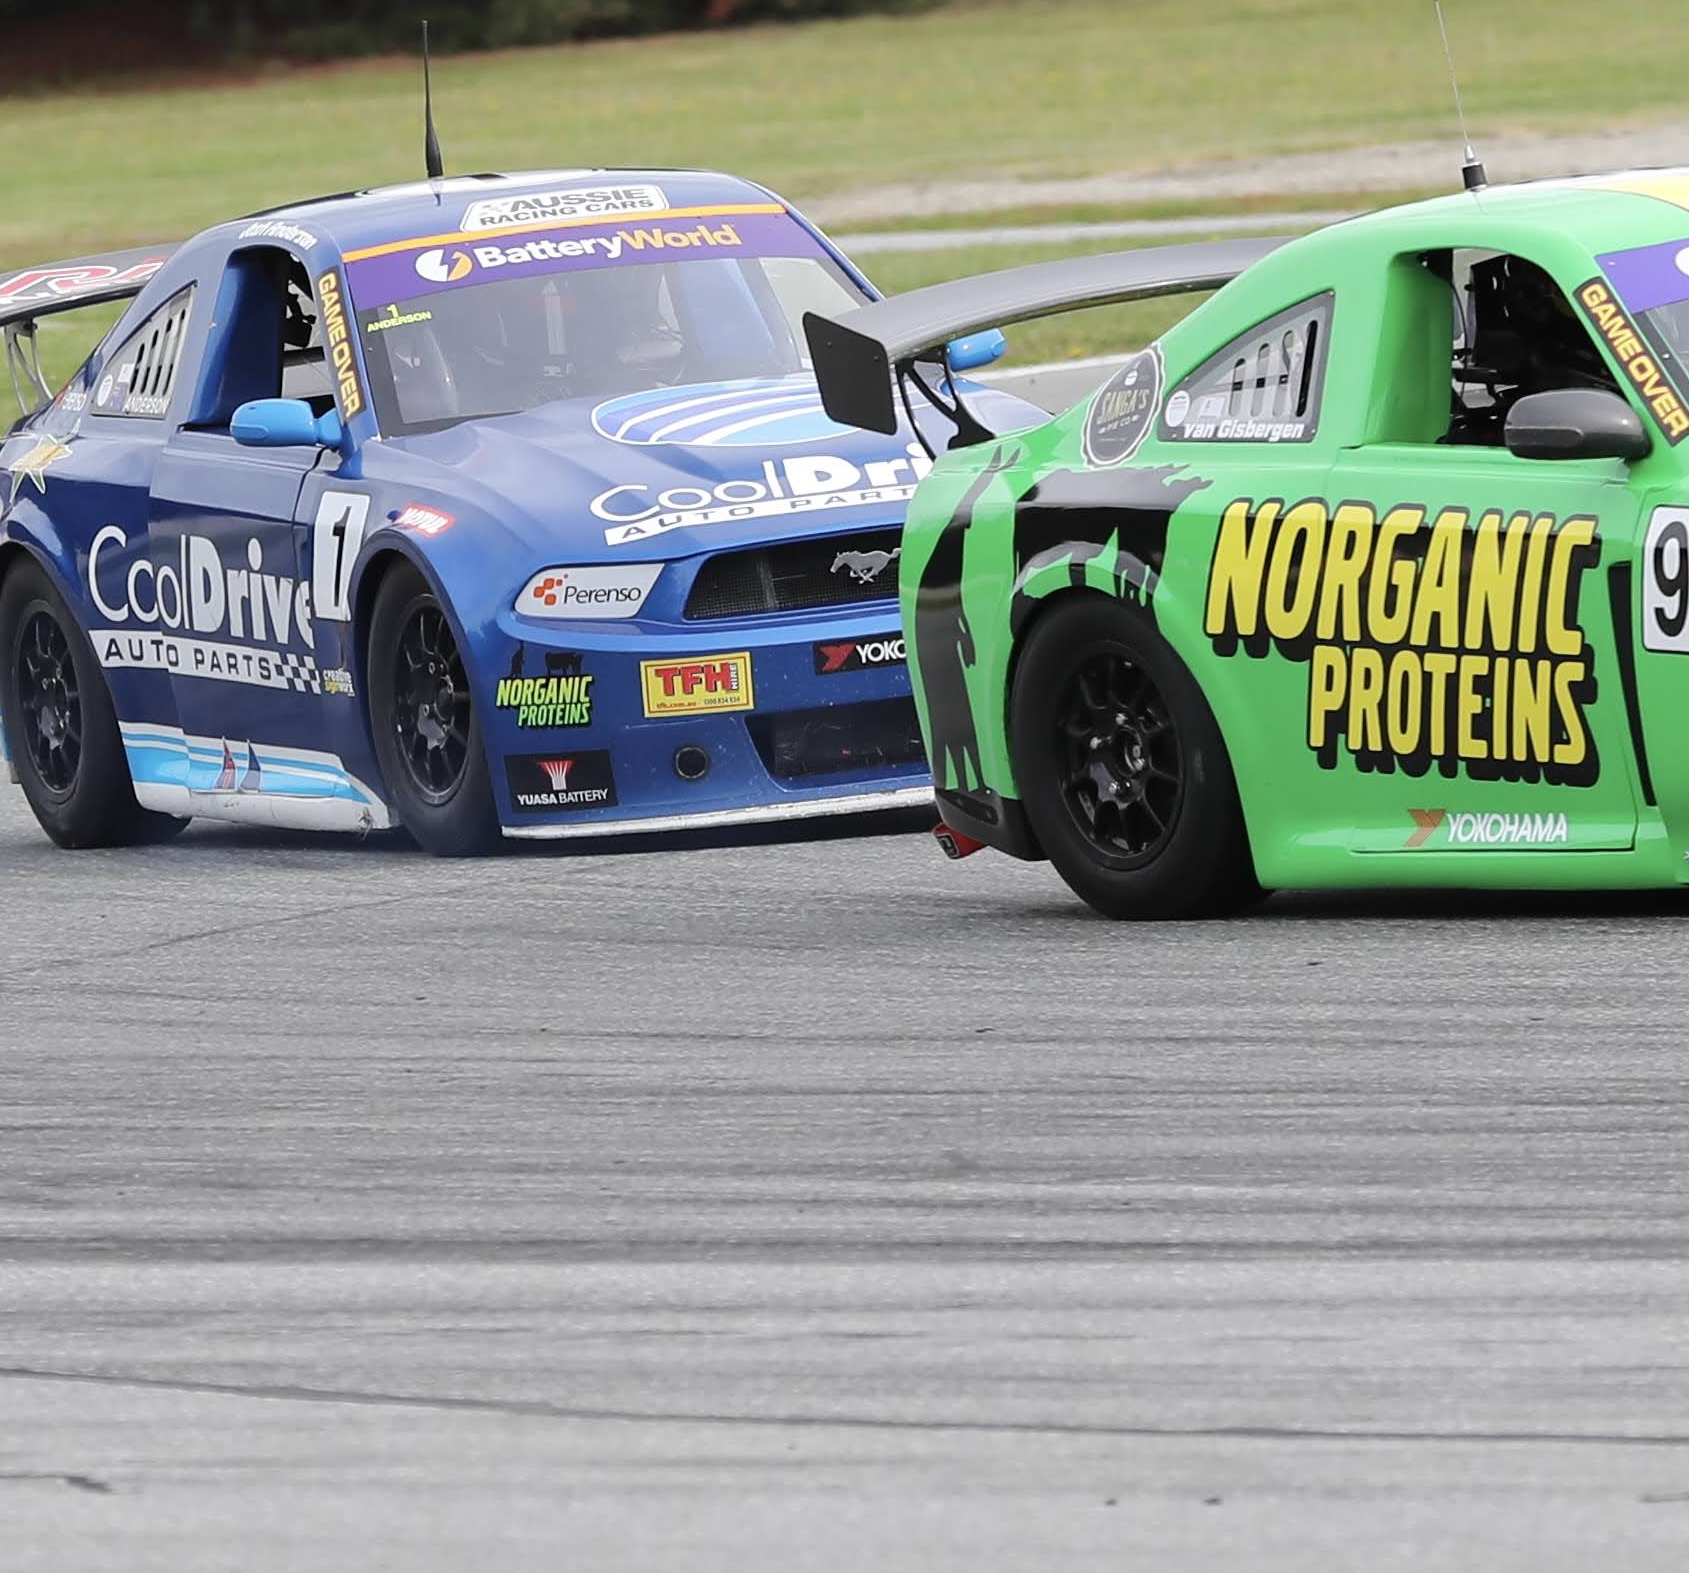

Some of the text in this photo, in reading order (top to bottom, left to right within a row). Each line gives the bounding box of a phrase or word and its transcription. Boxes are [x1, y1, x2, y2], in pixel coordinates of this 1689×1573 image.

[479, 199, 654, 226] RACING CARS
[510, 188, 650, 212] AUSSIE
[367, 311, 432, 333] ANDERSON
[386, 304, 400, 318] 1
[1184, 419, 1305, 442] van Gisbergen
[619, 505, 755, 539] AUTO
[331, 505, 353, 608] 1
[563, 582, 642, 605] Perenso
[1205, 501, 1597, 657] NORGANIC
[104, 638, 274, 681] AUTO PARTS
[496, 675, 593, 708] NORGANIC
[655, 662, 731, 697] TFH
[518, 702, 591, 727] PROTEINS
[1309, 644, 1587, 766] PROTEINS
[517, 788, 609, 805] YUASA BATTERY
[1446, 810, 1569, 844] YOKOHAMA
